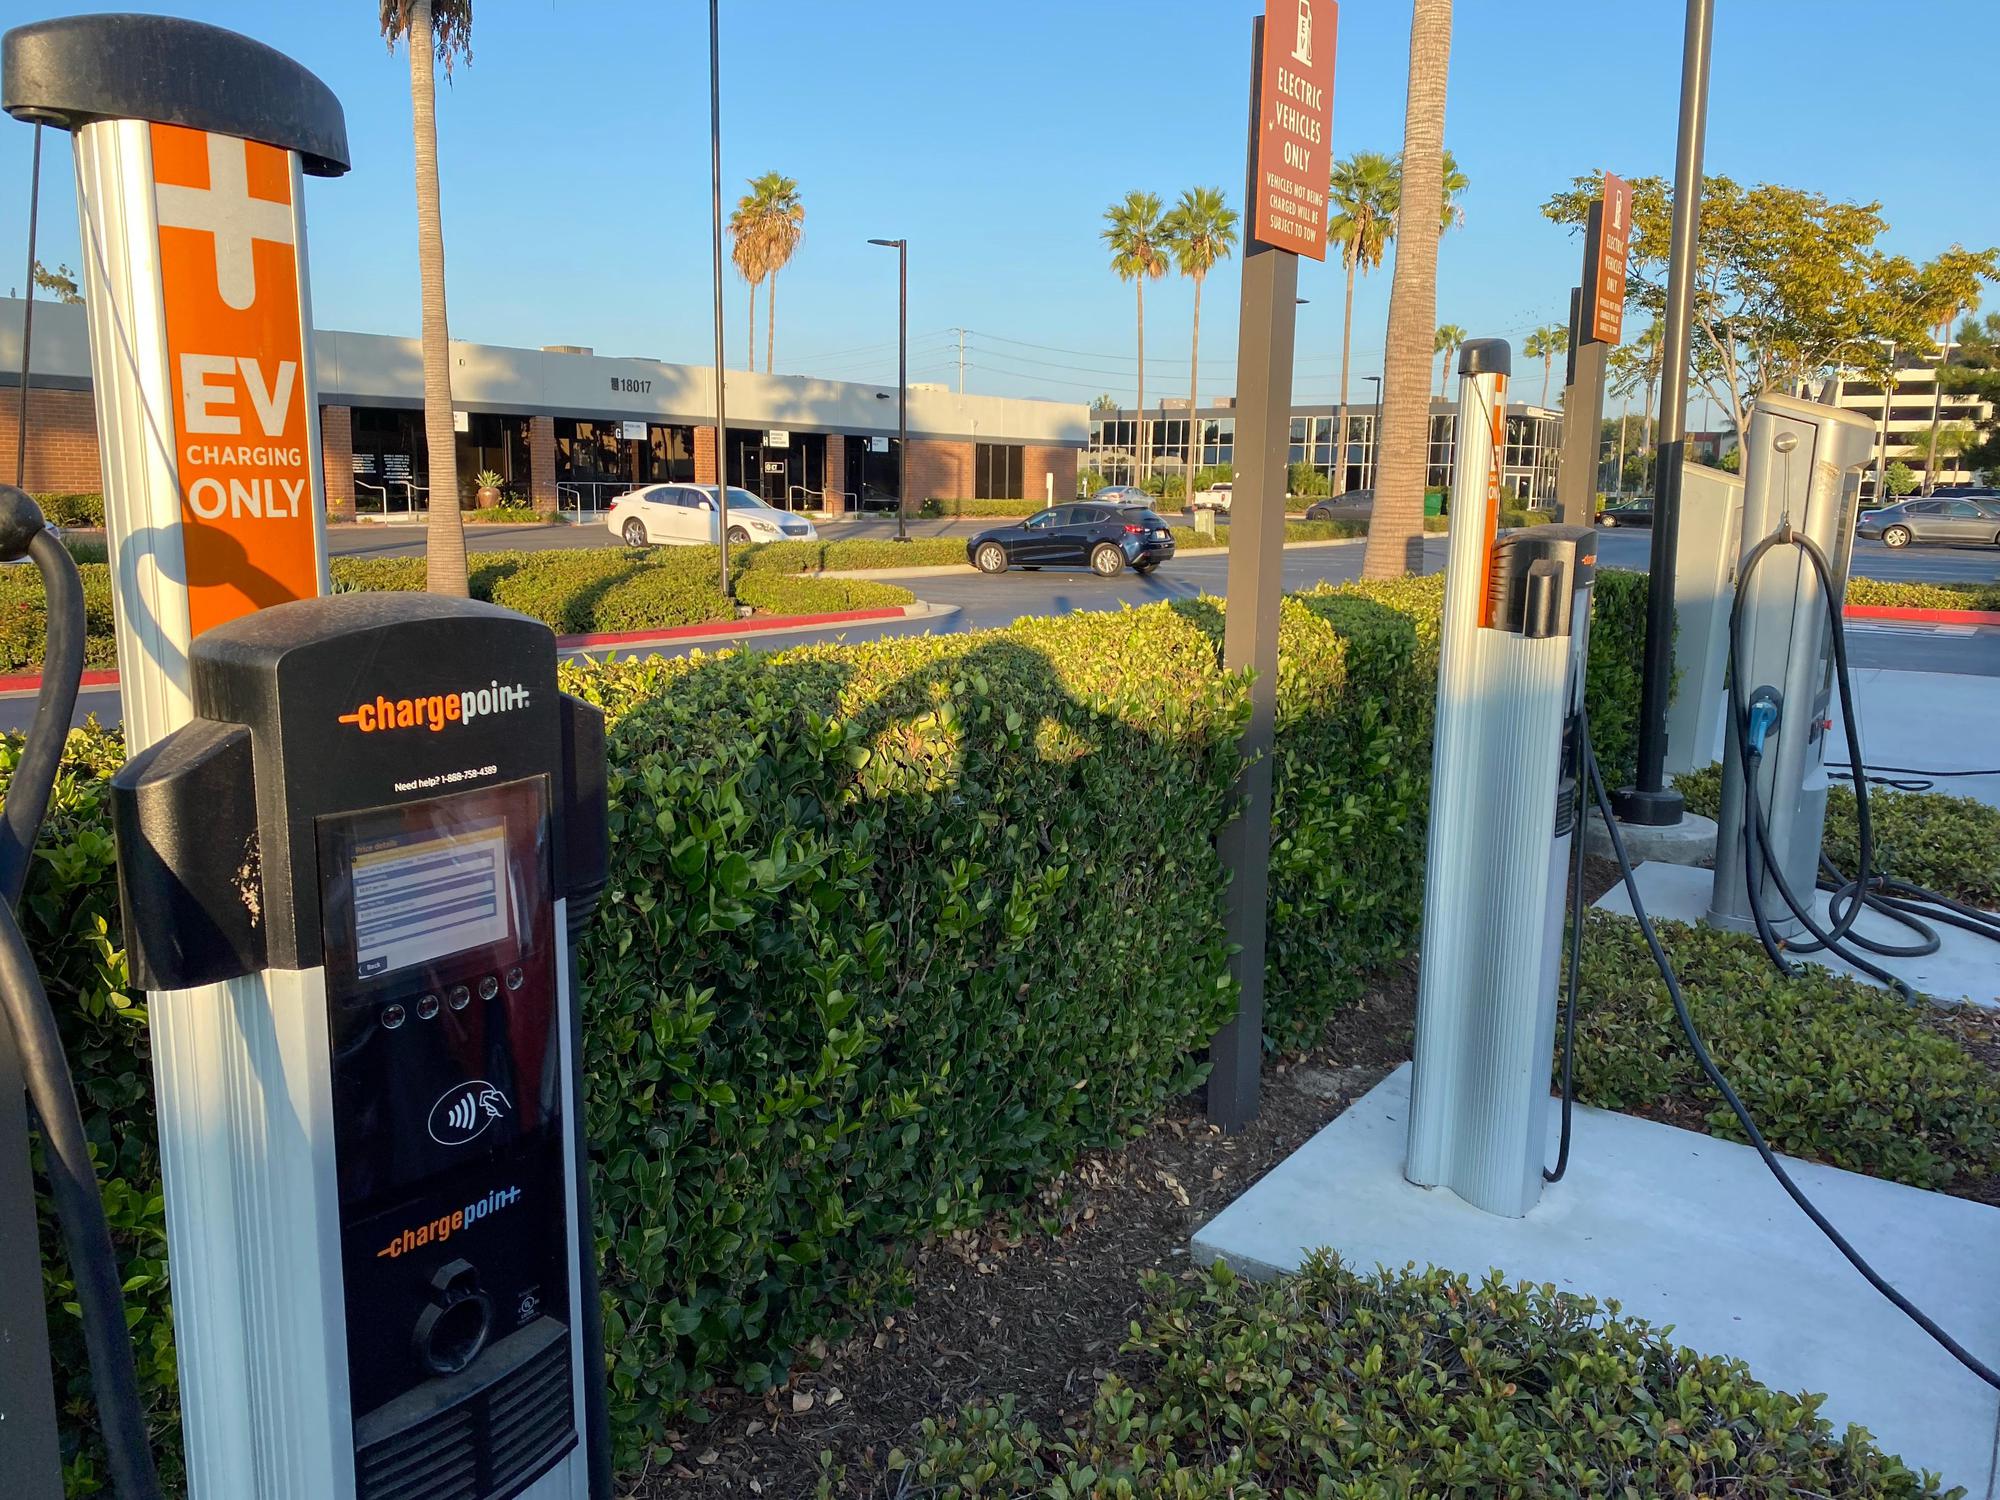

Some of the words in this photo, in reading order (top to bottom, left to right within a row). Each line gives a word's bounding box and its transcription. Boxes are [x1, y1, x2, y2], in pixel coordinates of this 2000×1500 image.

[1278, 66, 1322, 112] ELECTRIC
[1276, 100, 1321, 144] VEHICLES
[1284, 141, 1310, 173] ONLY
[1266, 171, 1293, 195] VEHICLES
[1294, 183, 1306, 200] NOT
[1307, 189, 1323, 207] BEING
[1270, 194, 1297, 216] CHARGED
[1298, 204, 1310, 221] WILL
[1312, 210, 1319, 225] BE
[1270, 214, 1294, 235] SUBJECT
[1295, 223, 1303, 238] TO
[1304, 226, 1317, 243] TOW
[180, 353, 297, 437] EV
[620, 378, 652, 394] 18017
[615, 428, 621, 439] G
[763, 436, 769, 447] H
[186, 445, 301, 467] CHARGING
[189, 477, 305, 520] ONLY
[394, 780, 418, 792] Need
[418, 775, 441, 788] help?
[441, 765, 498, 784] 1-888-758-4389
